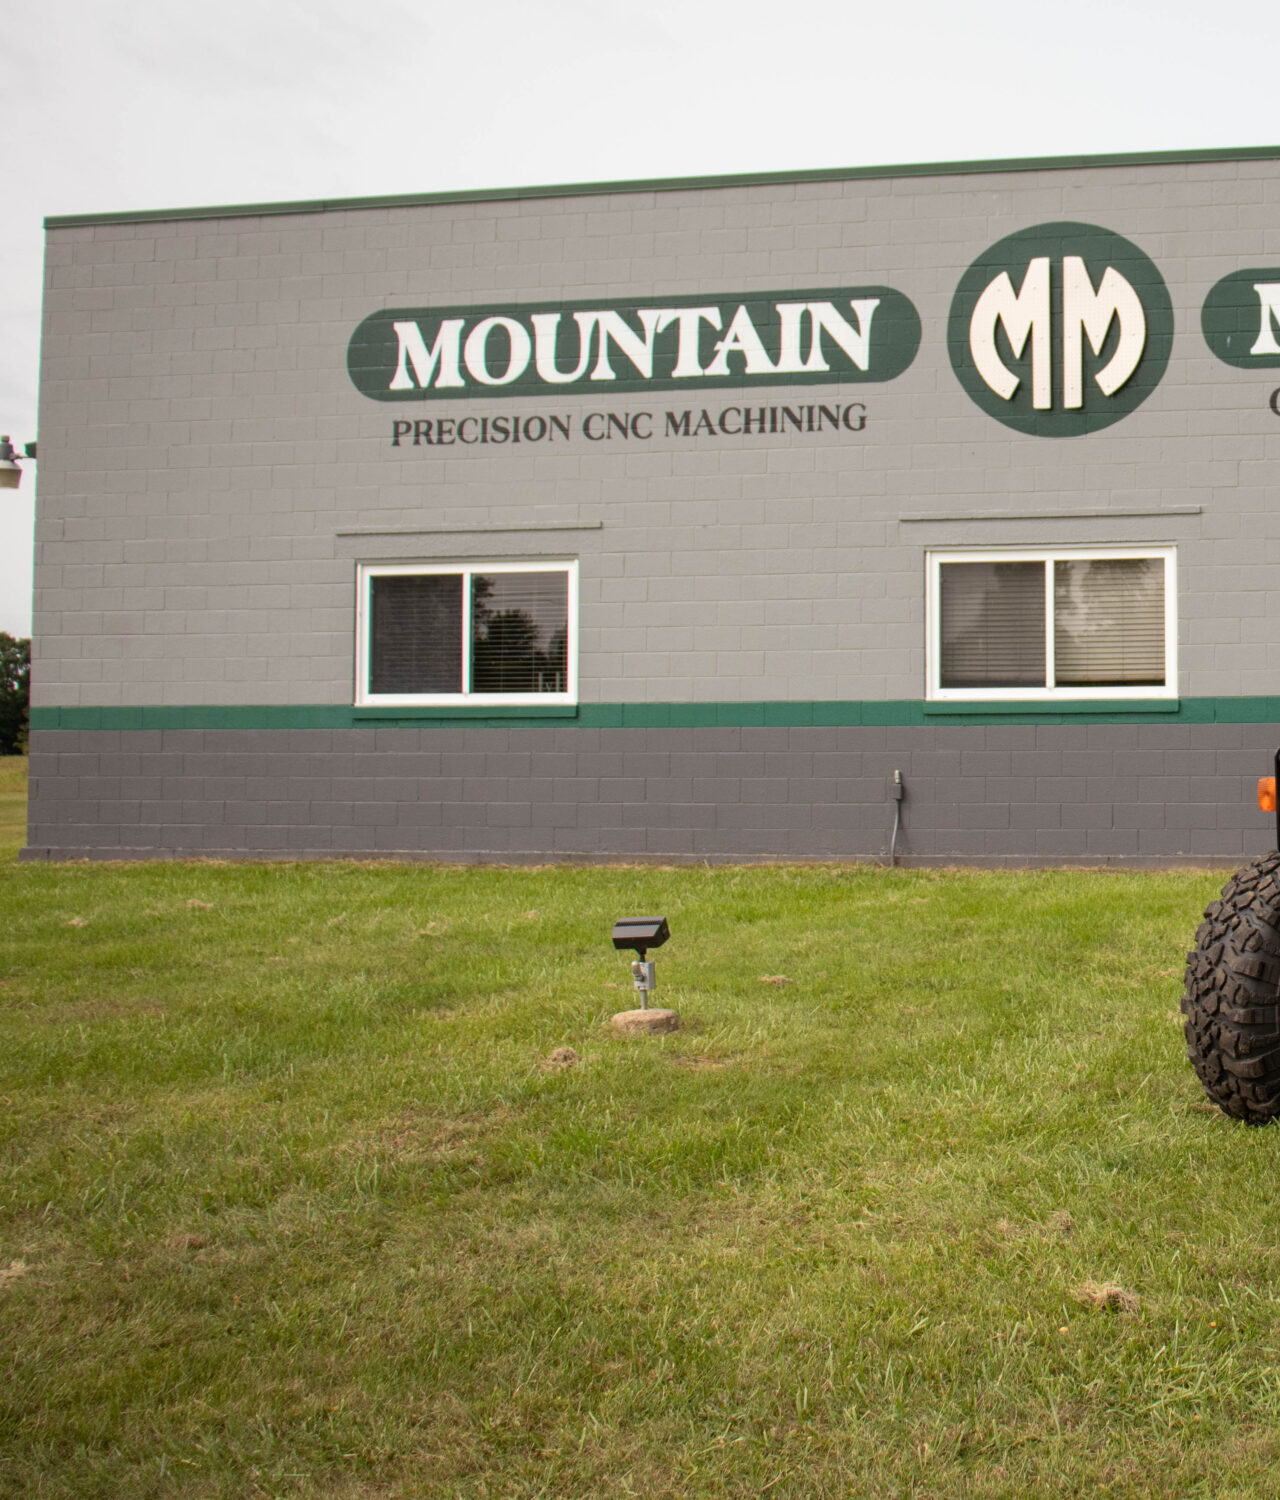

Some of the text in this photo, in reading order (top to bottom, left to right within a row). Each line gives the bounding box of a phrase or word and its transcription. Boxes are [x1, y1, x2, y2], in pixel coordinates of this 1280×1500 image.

[389, 298, 880, 391] MOUNTAIN
[391, 403, 867, 447] PRECISION CNC MACHINING
